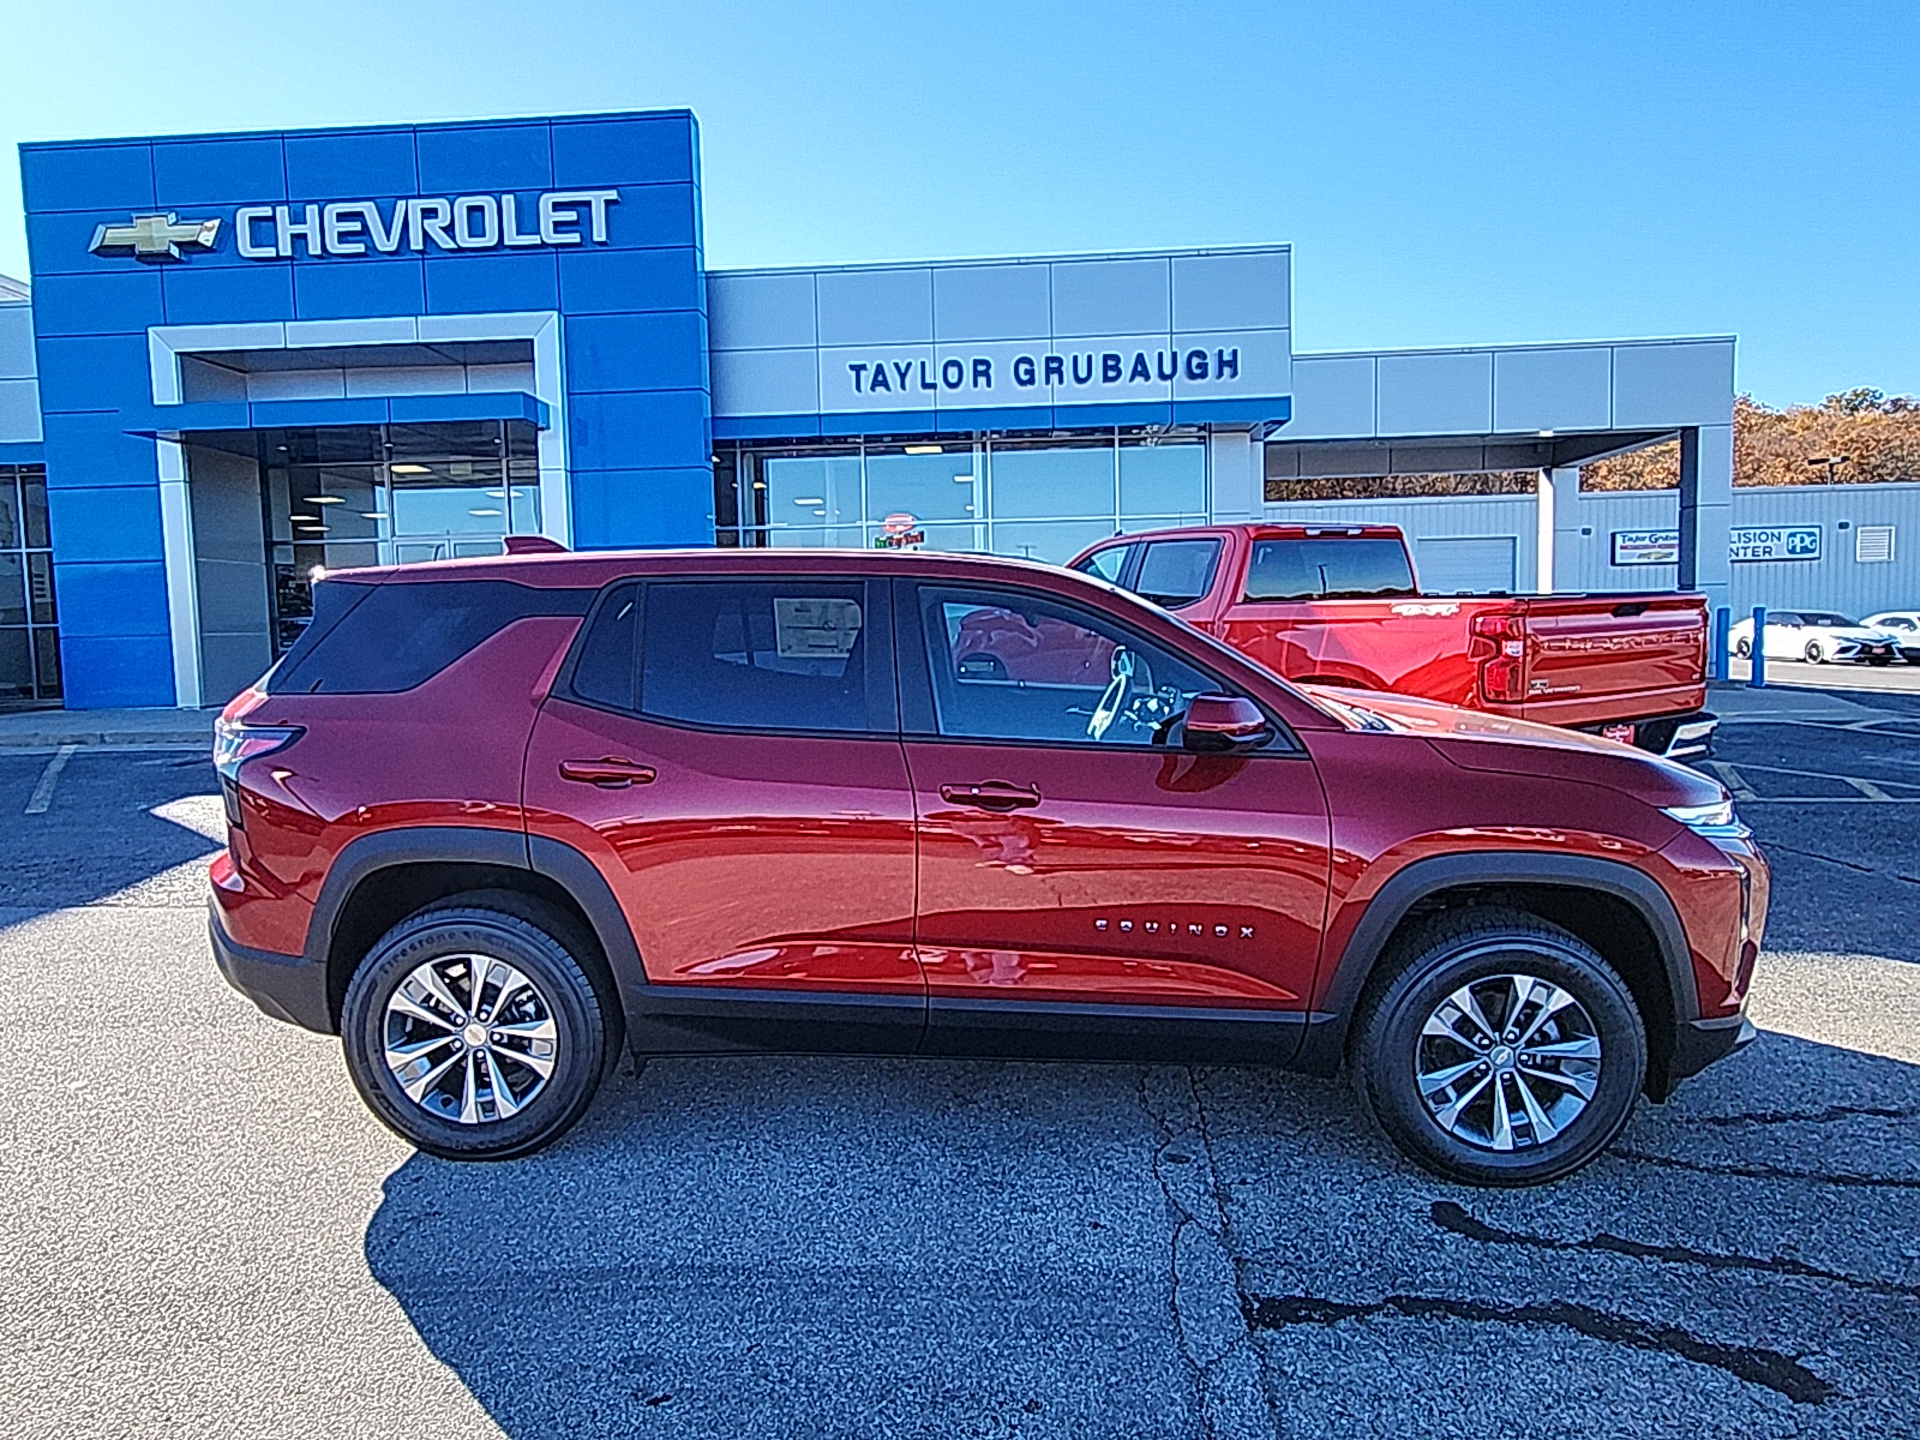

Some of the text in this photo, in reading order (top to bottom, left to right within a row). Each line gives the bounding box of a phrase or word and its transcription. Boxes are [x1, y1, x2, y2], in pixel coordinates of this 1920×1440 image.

[235, 189, 620, 259] CHEVROLET
[848, 348, 1240, 393] TAYLOR GRUBAUGH
[1787, 533, 1817, 553] PPG
[1095, 919, 1254, 938] EQUINOX
